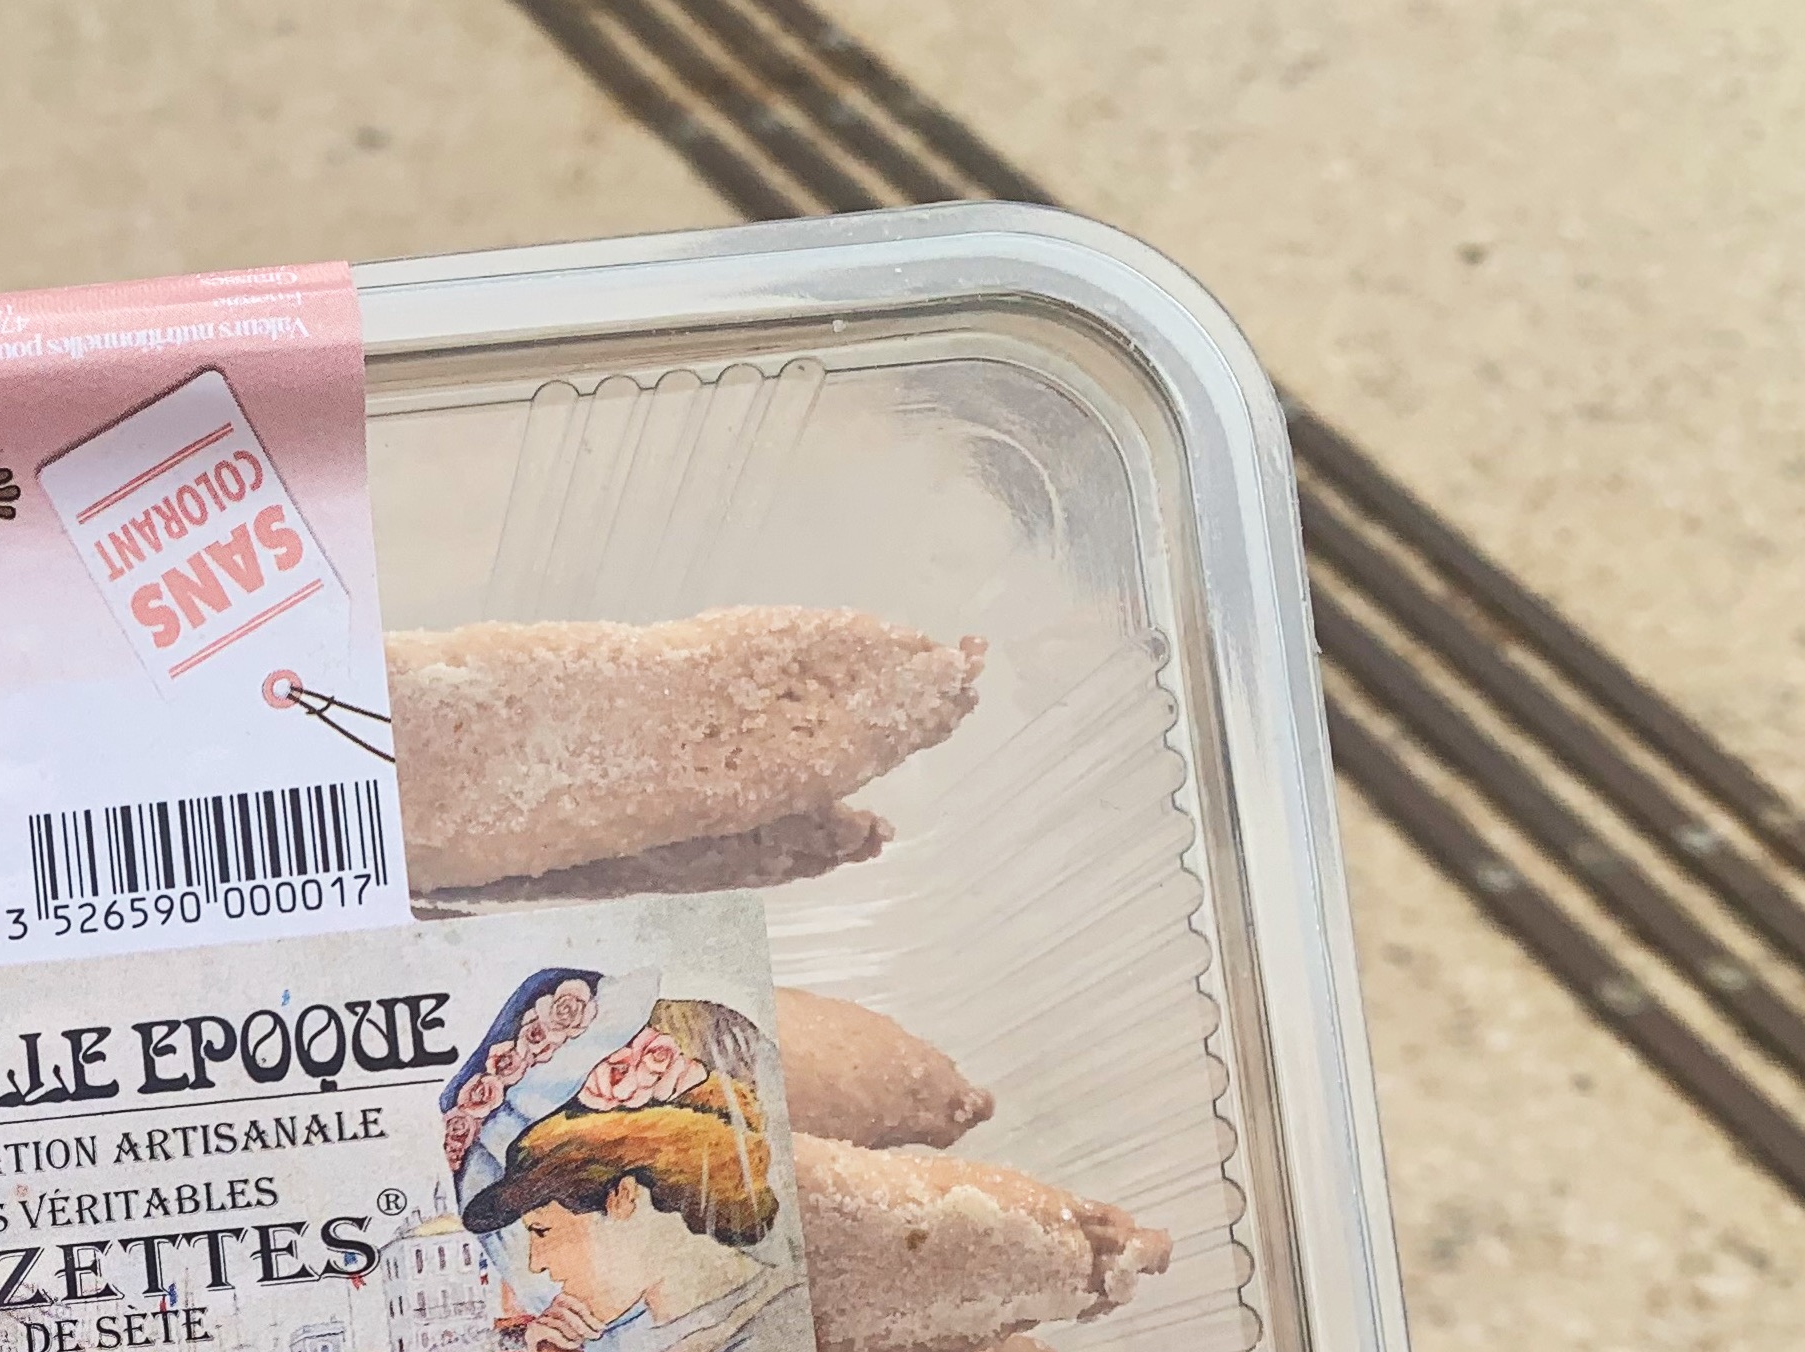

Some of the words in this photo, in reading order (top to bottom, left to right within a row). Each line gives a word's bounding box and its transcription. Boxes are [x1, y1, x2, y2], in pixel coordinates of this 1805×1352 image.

[48, 321, 215, 359] nutritionnelles
[218, 315, 312, 341] Valeurs
[95, 449, 264, 582] COLORANT
[130, 502, 305, 649] SANS
[5, 907, 29, 941] 3
[53, 891, 202, 936] 526590
[222, 873, 372, 919] 000017
[130, 992, 460, 1094] EPOQUE
[114, 1106, 389, 1165] ARTISANALE
[19, 1176, 281, 1231] VÉRITABLES
[96, 1306, 215, 1348] SÈTE
